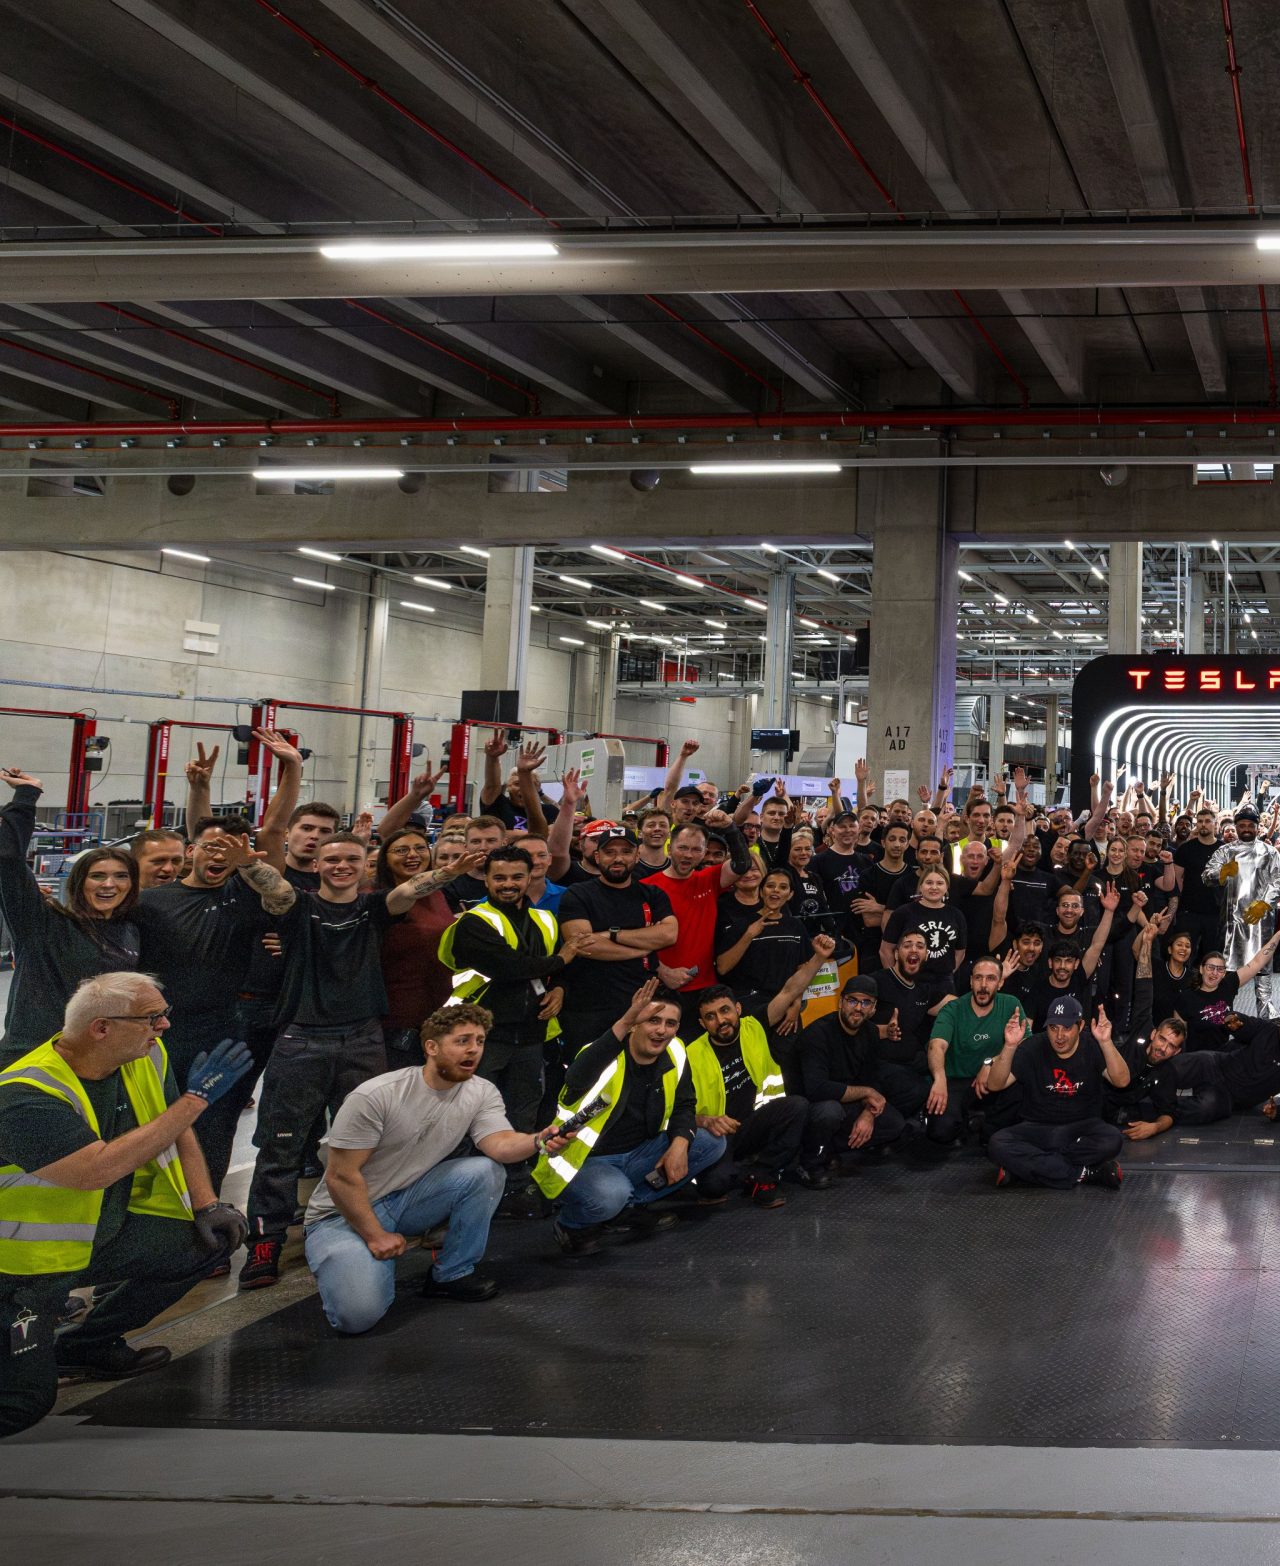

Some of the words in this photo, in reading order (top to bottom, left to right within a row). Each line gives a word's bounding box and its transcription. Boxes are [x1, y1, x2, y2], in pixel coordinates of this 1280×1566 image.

[885, 726, 911, 738] A17
[889, 739, 906, 751] AD
[918, 920, 957, 941] ERLIN
